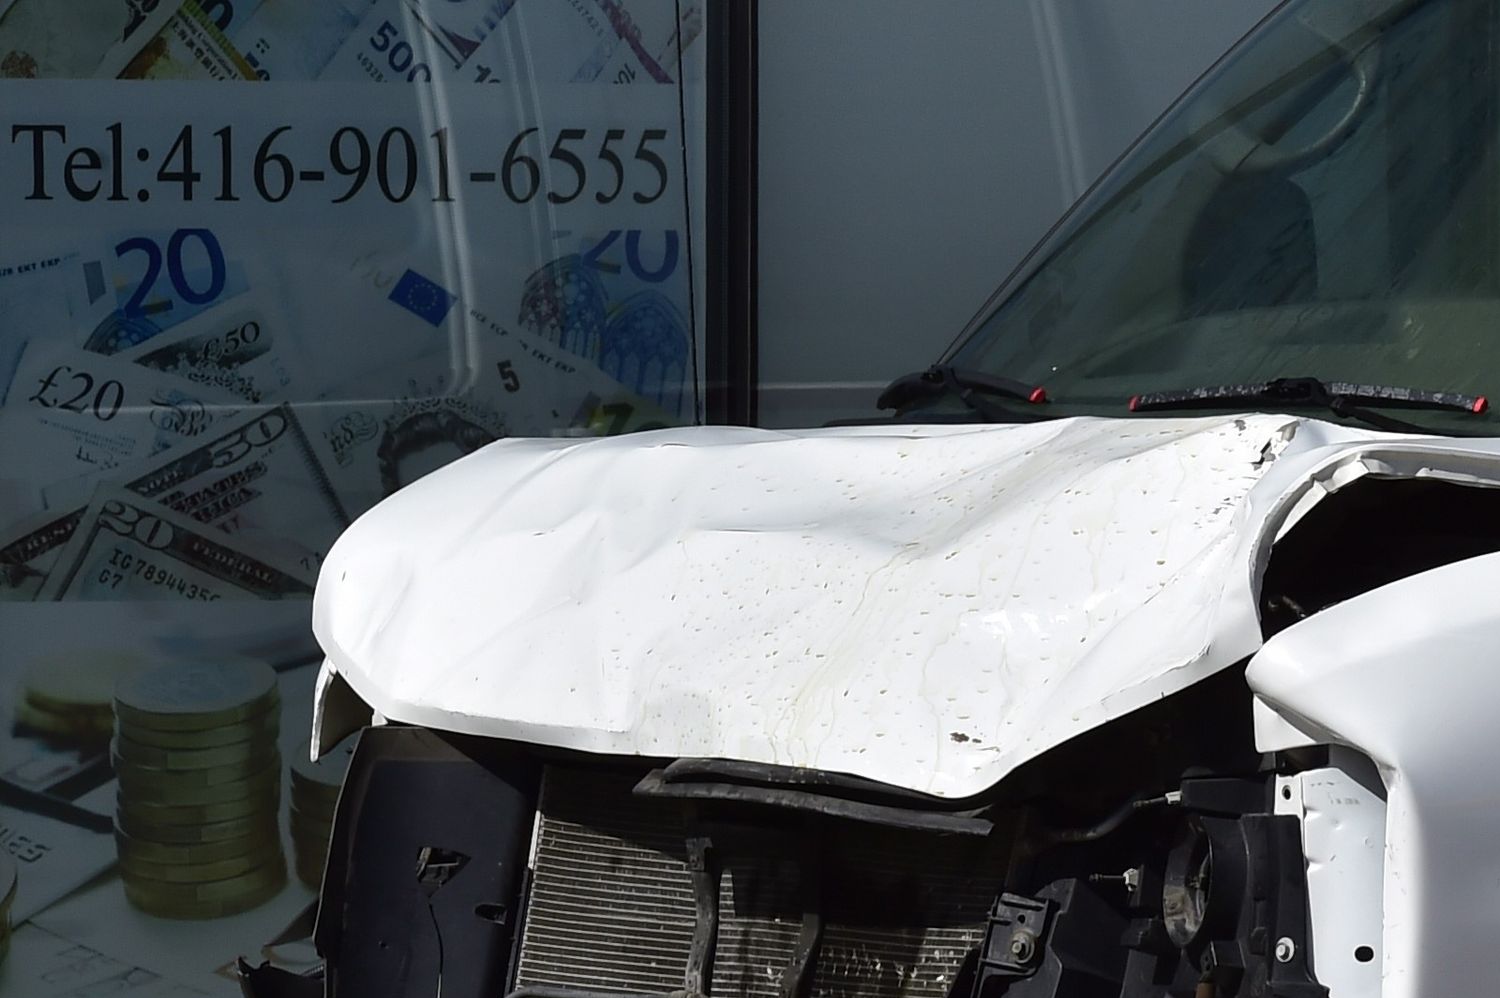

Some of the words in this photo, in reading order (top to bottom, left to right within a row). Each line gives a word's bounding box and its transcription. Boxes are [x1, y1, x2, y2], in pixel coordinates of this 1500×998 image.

[11, 121, 669, 205] Tel:416-901-6555
[115, 228, 226, 320] 20
[28, 365, 125, 422] £20
[497, 359, 520, 393] 5
[101, 500, 175, 550] 20
